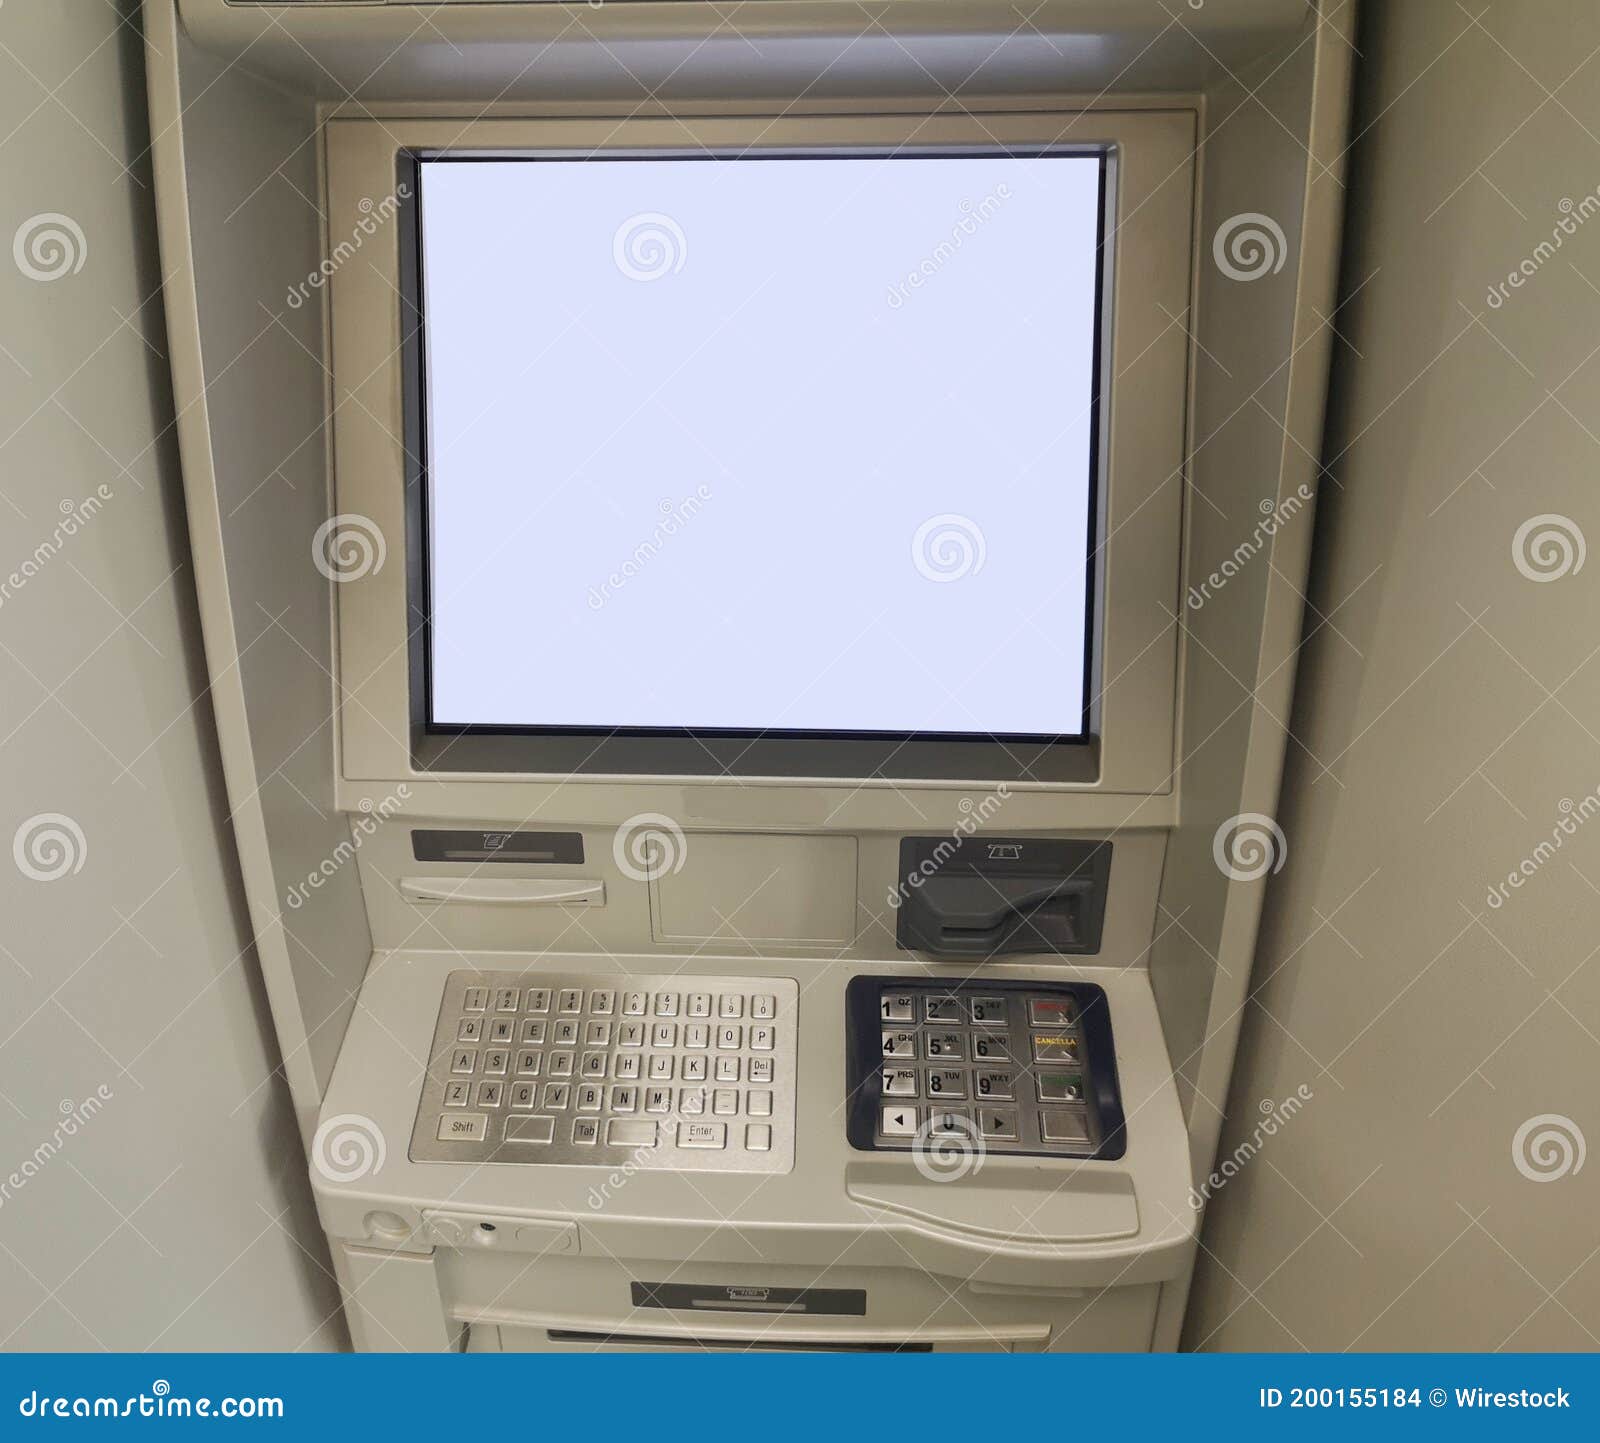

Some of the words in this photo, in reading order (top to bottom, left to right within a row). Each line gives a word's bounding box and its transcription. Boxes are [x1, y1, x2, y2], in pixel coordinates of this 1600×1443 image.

[882, 1001, 890, 1016] 1
[928, 1002, 939, 1018] 2
[974, 1004, 984, 1020] 3
[883, 1037, 895, 1053] 4
[930, 1039, 940, 1055] 5
[977, 1040, 988, 1056] 6
[884, 1074, 894, 1091] 7
[898, 1070, 914, 1079] PRS
[931, 1075, 942, 1092] 8
[979, 1078, 991, 1094] 9
[452, 1122, 474, 1132] Shift
[579, 1126, 595, 1136] Tab
[689, 1125, 713, 1135] Enter
[943, 1112, 954, 1130] 0
